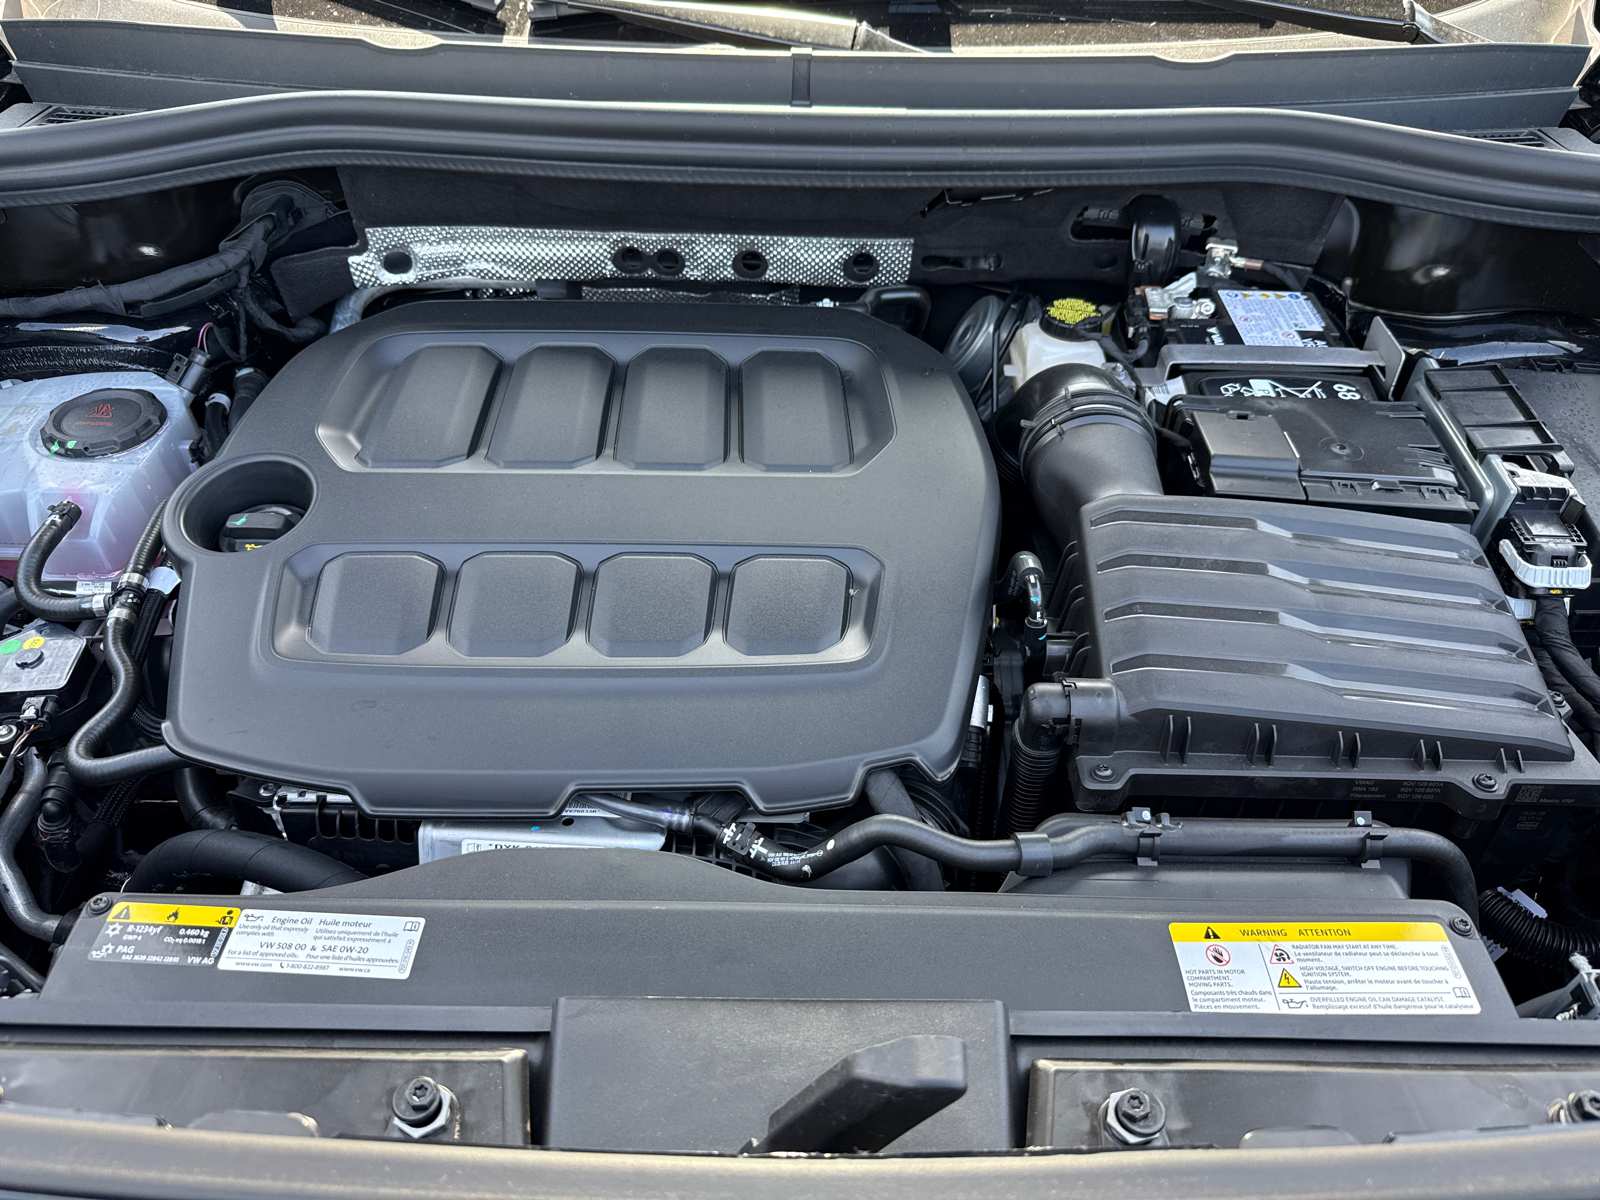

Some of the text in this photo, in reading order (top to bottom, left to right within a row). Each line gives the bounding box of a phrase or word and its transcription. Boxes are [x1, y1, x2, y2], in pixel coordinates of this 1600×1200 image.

[1333, 384, 1360, 399] 68
[272, 916, 299, 925] Engine
[127, 925, 163, 936] R-1234yf
[200, 929, 210, 938] kg
[339, 946, 369, 954] 0W-20
